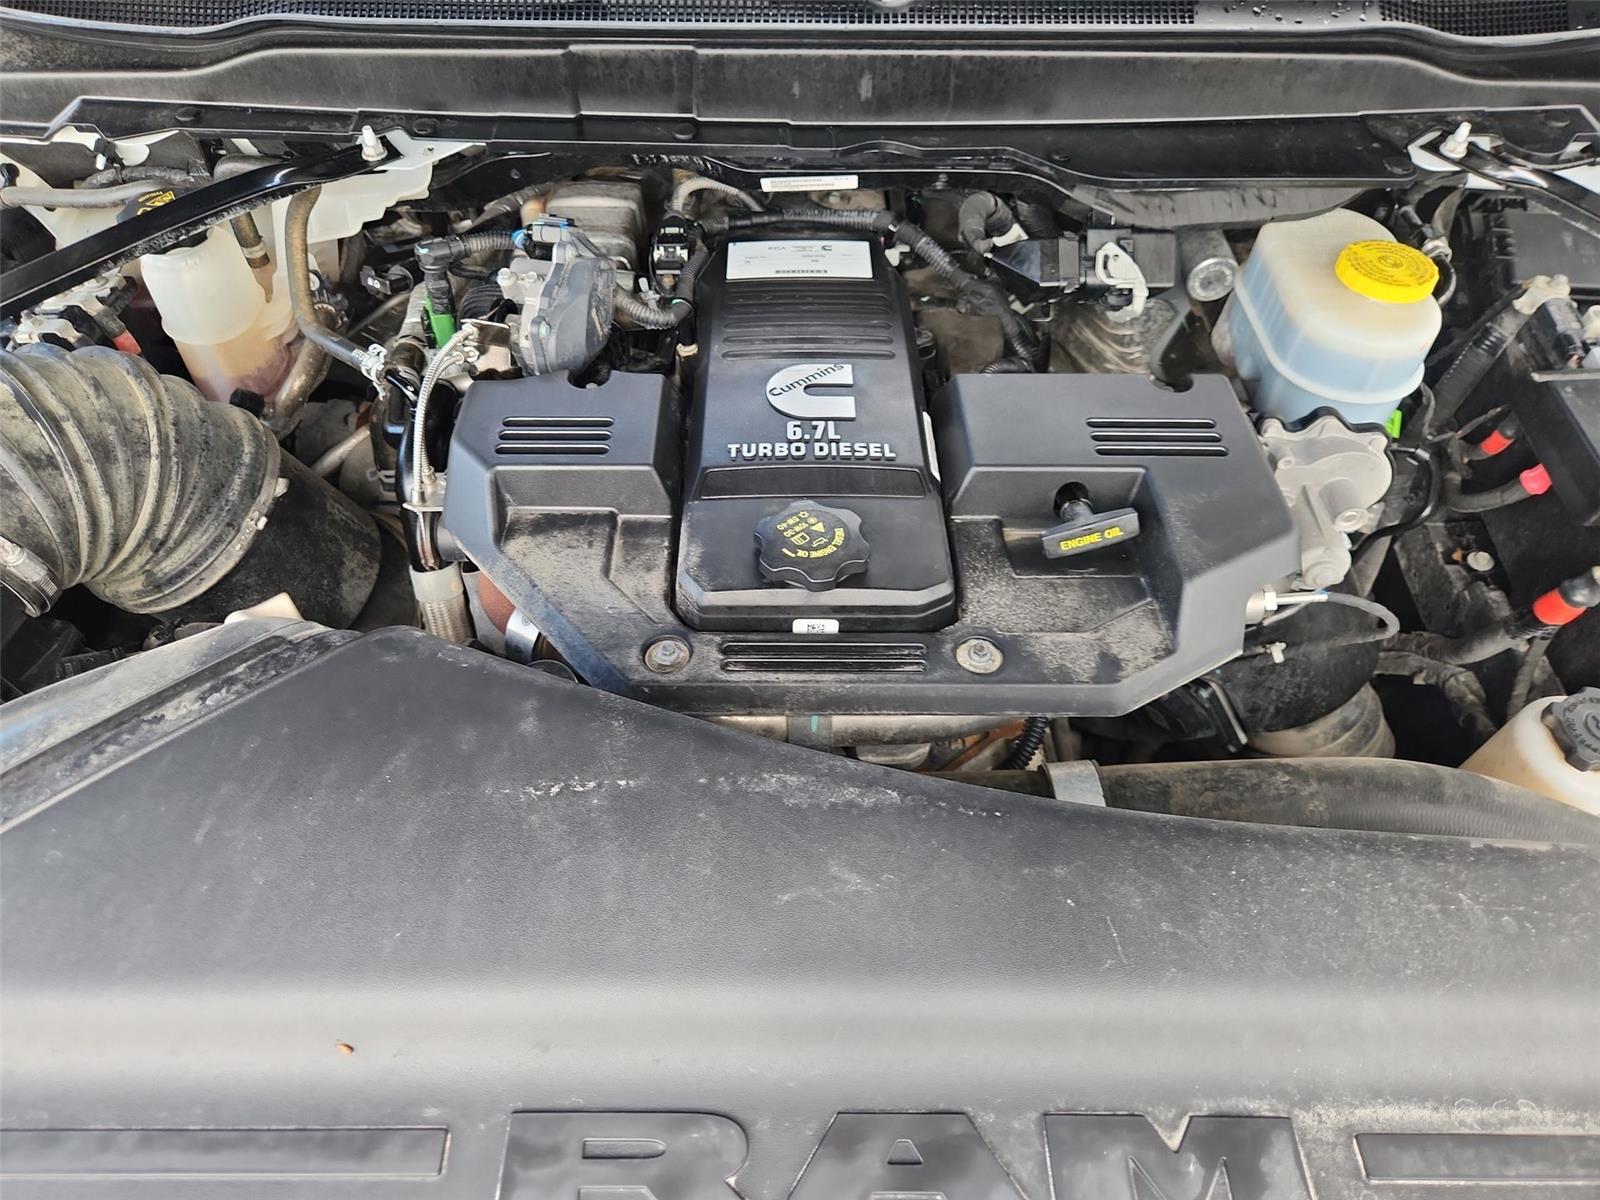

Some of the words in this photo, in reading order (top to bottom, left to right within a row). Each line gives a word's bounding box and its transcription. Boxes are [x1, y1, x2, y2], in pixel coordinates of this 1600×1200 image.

[769, 363, 844, 397] Cummins
[786, 420, 841, 441] 6.7L
[727, 442, 806, 459] TURBO
[814, 442, 897, 460] DIESEL
[1060, 532, 1103, 550] ENGINE
[1103, 526, 1125, 539] OIL
[496, 1110, 1317, 1200] RAM
